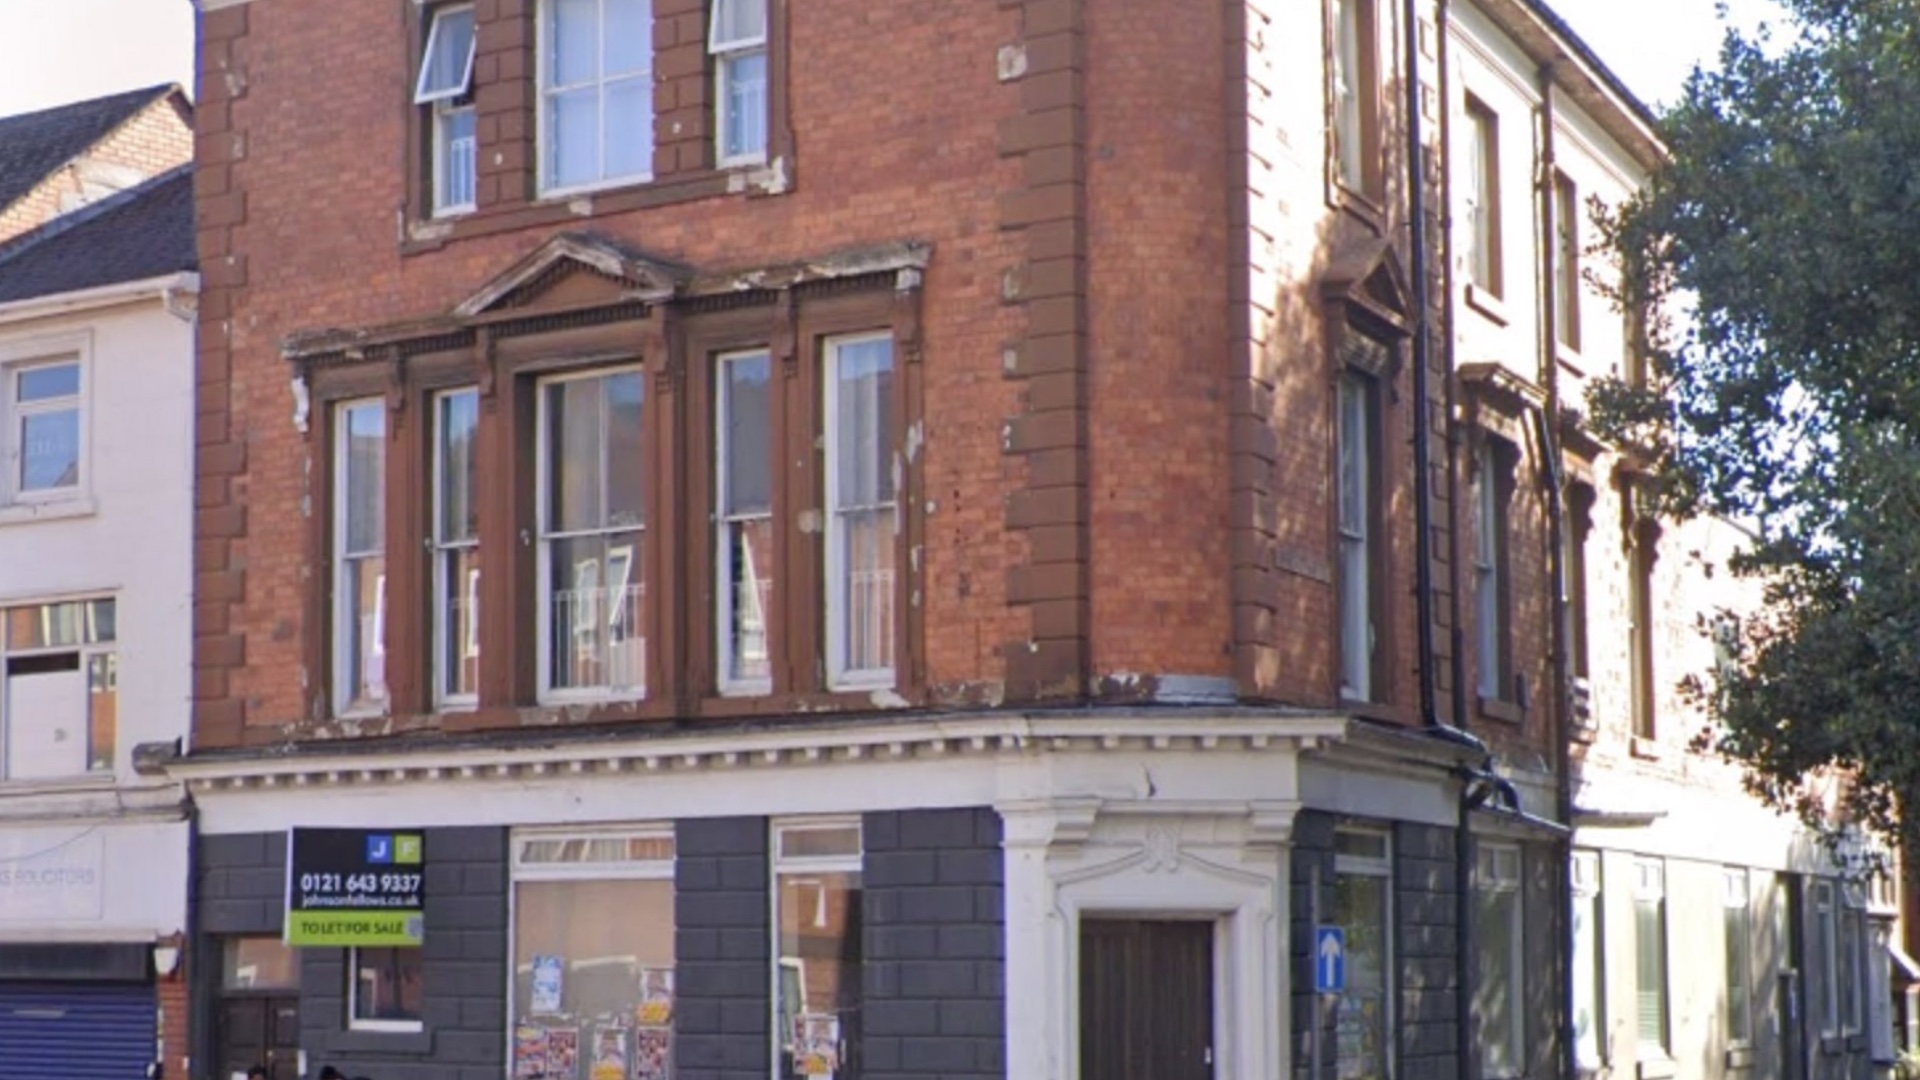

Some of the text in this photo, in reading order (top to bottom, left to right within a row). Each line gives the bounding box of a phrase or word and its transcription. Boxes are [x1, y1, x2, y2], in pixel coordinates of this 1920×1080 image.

[15, 867, 95, 886] SOLICITORS
[301, 872, 421, 892] 0121 643 9337
[302, 921, 319, 934] TO
[374, 921, 404, 934] SALE
